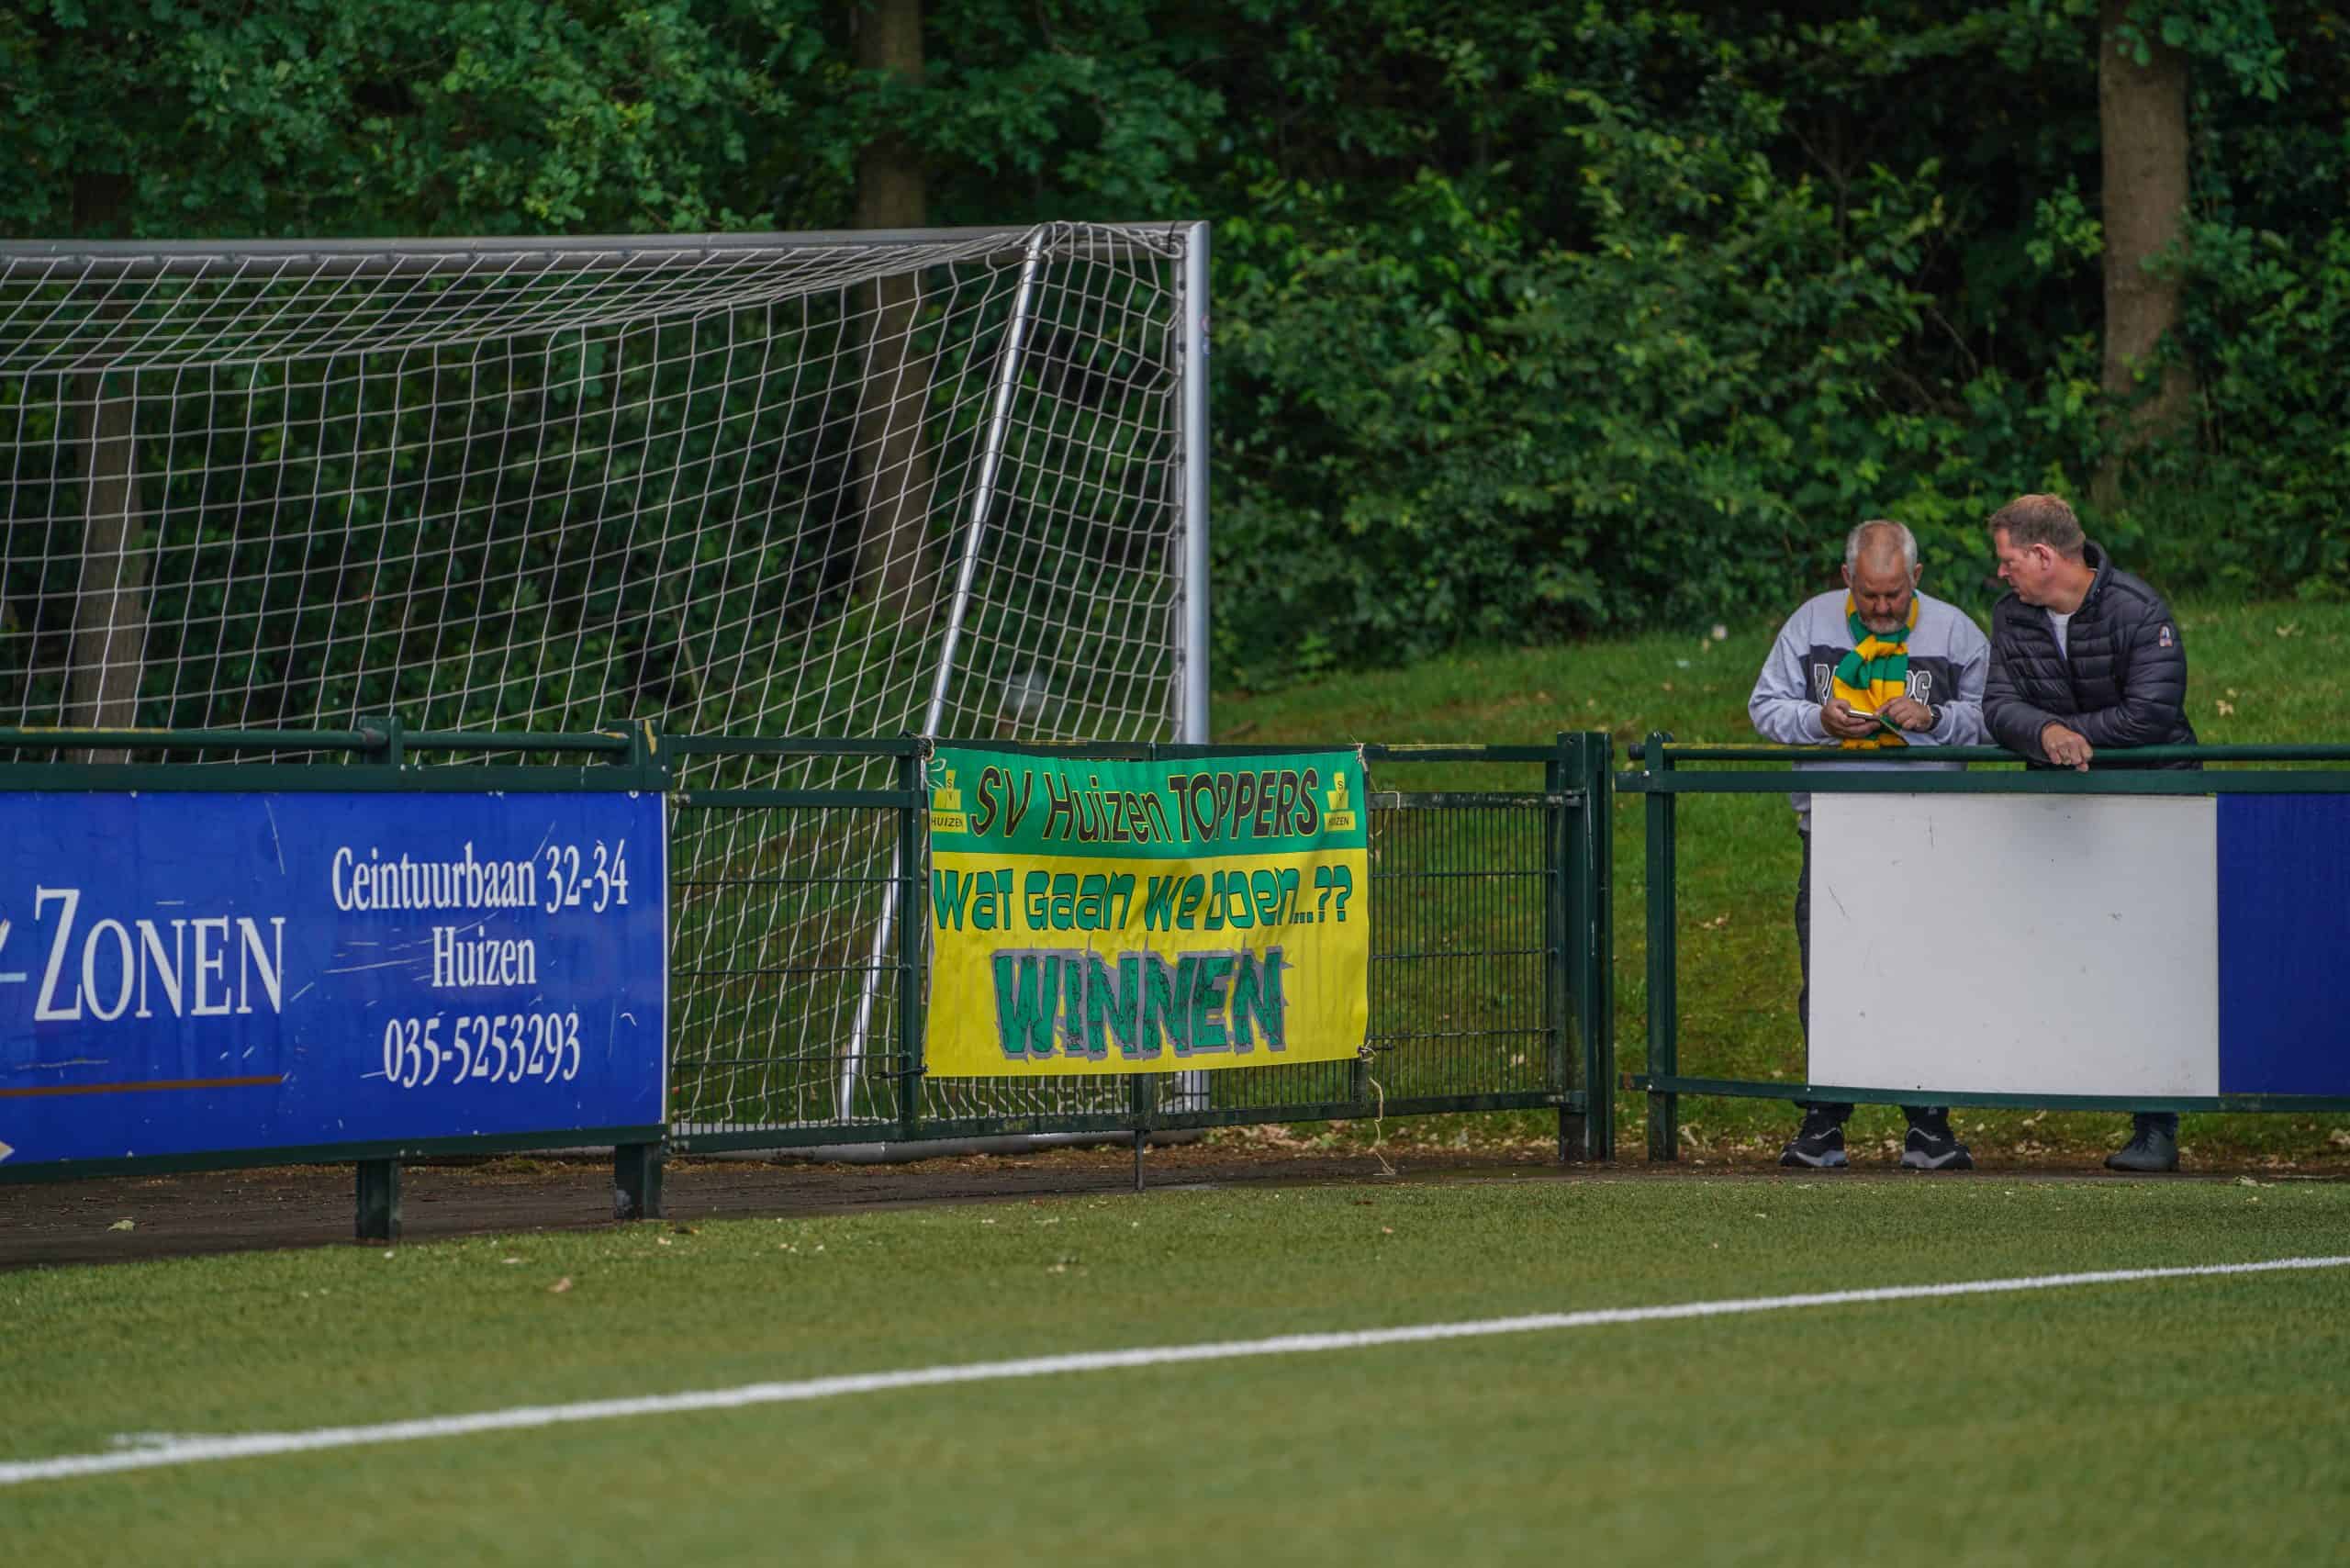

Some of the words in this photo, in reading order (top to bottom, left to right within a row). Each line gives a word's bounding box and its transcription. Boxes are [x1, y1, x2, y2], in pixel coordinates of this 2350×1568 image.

[969, 765, 1034, 837] SV
[1042, 772, 1174, 844] Huizen
[1168, 767, 1319, 843] TOPPERS
[331, 841, 537, 912] Ceintuurbaan
[545, 838, 629, 914] 32-34
[431, 924, 537, 987] Huizen
[991, 946, 1286, 1060] WINNEN
[384, 1012, 580, 1088] 035-5253293
